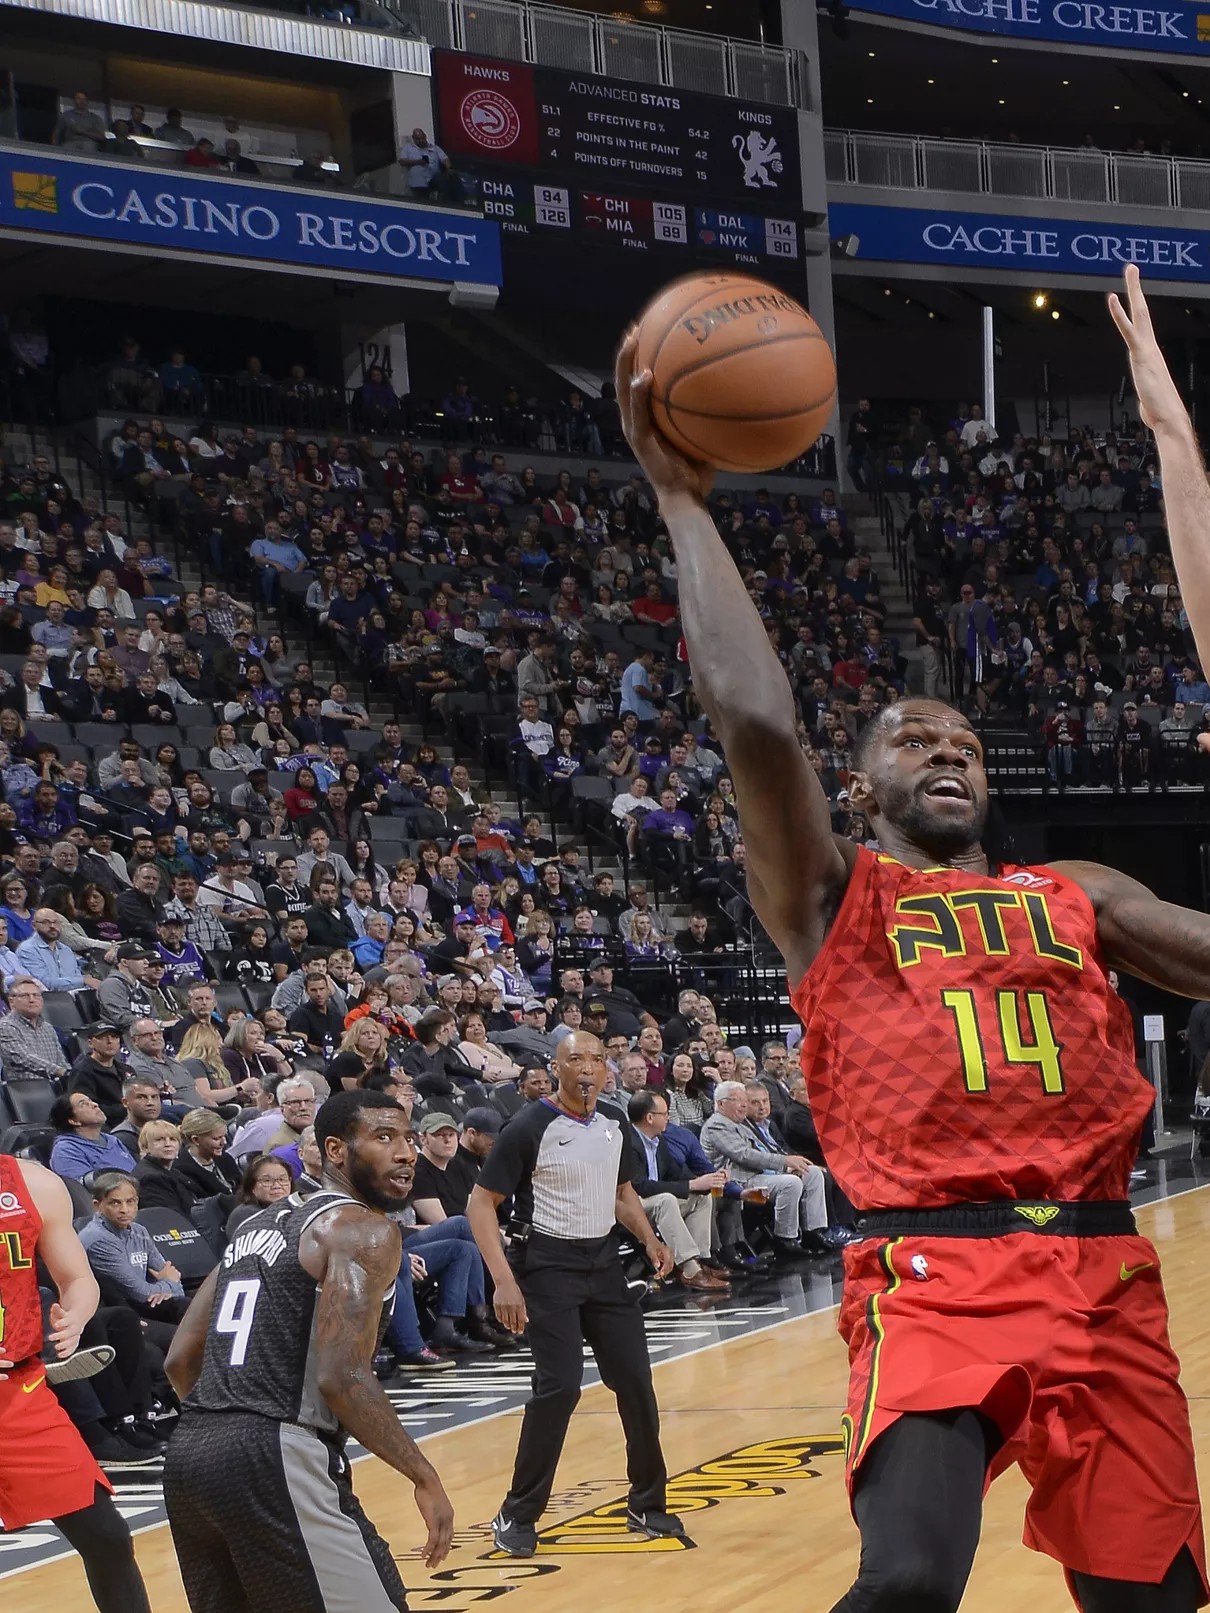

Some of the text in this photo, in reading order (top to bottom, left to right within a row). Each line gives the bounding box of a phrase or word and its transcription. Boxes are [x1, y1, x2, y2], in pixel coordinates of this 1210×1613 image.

[911, 0, 1041, 24] ACHE
[1052, 0, 1188, 39] CREEK
[464, 65, 510, 82] HAWKS
[569, 81, 681, 110] ADVANCED STATS
[542, 104, 561, 117] 51.1
[587, 111, 641, 130] EFFECTIVE
[643, 120, 657, 132] FG
[688, 127, 710, 140] 54.2
[738, 110, 773, 126] KINGS
[547, 126, 708, 161] 22 POINTS IN THE PAINT 42
[550, 148, 707, 181] 4 POINTS OFF TURNOVERS 15
[483, 181, 563, 204] CHA 94
[484, 200, 567, 224] BOS 126
[605, 198, 683, 221] CHI 105
[73, 183, 477, 266] CASINO RESORT
[502, 221, 530, 234] FINAL
[606, 217, 681, 239] MIA 89
[718, 214, 792, 236] DAL 114
[622, 237, 649, 250] FINAL
[719, 232, 792, 254] NYK 90
[922, 223, 1059, 258] CACHE
[1071, 234, 1202, 268] CREEK
[735, 253, 760, 264] FINAL
[889, 891, 1083, 969] ATL
[942, 989, 1065, 1096] 14
[216, 1278, 261, 1366] 9
